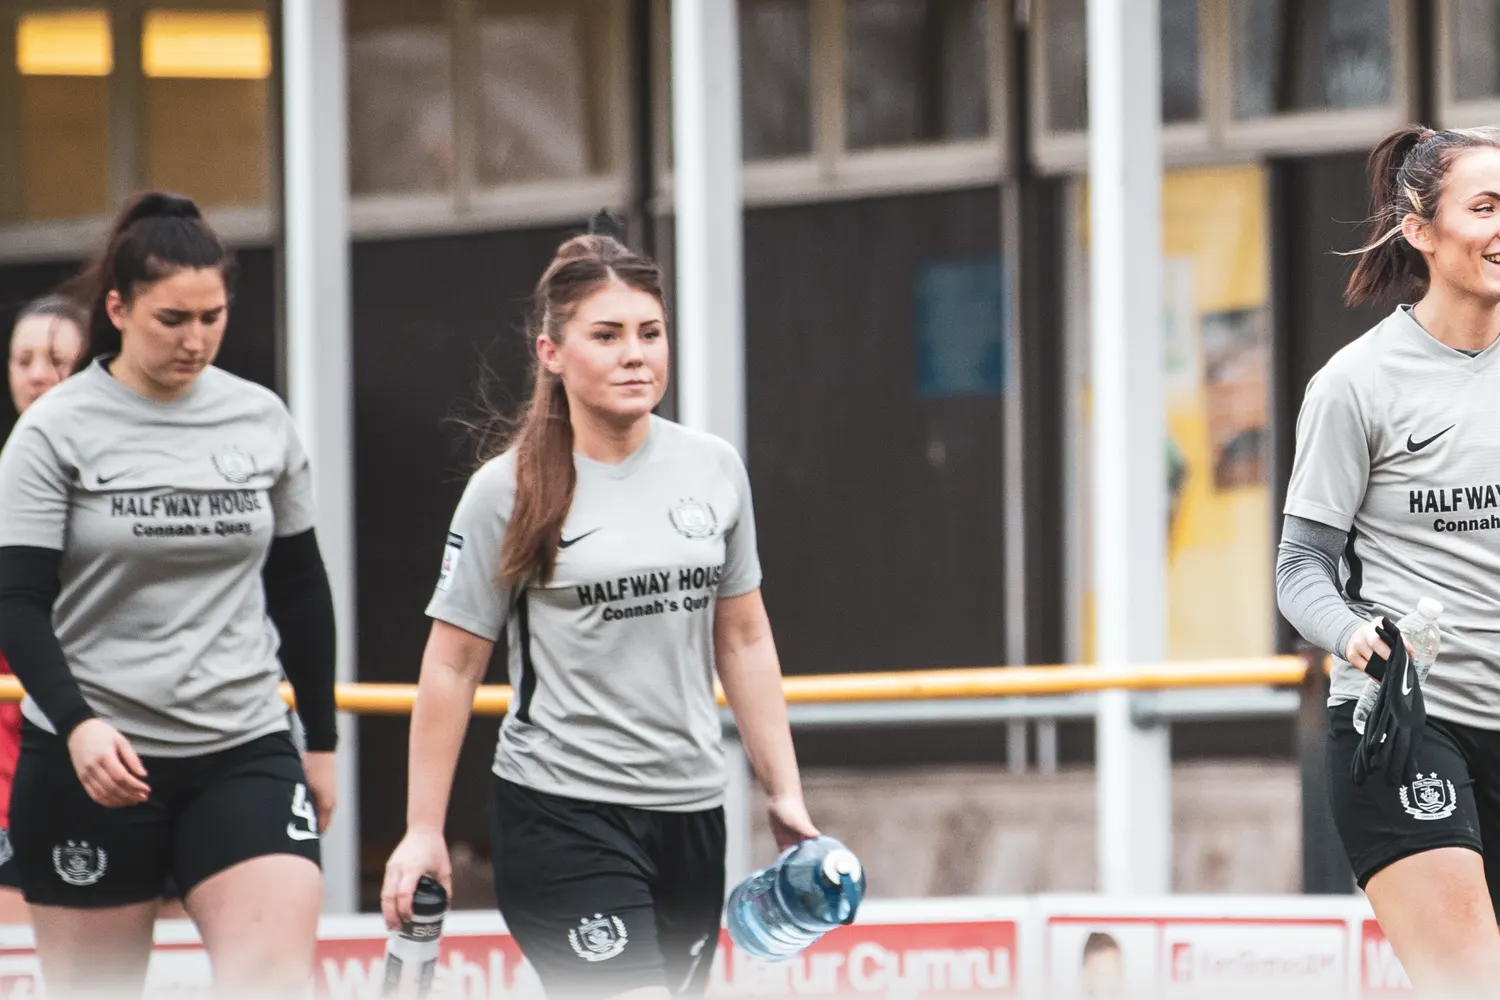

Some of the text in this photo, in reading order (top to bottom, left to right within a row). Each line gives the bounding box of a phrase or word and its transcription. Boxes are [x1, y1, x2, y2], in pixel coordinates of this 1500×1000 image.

[110, 488, 262, 517] HALFWAY HOUSE
[214, 519, 253, 537] Quay
[576, 565, 721, 606] HALFWAY HOUS
[601, 598, 678, 621] Connah's
[291, 783, 318, 833] 4
[321, 950, 486, 1000] Wsh
[849, 942, 1009, 1000] Cymru
